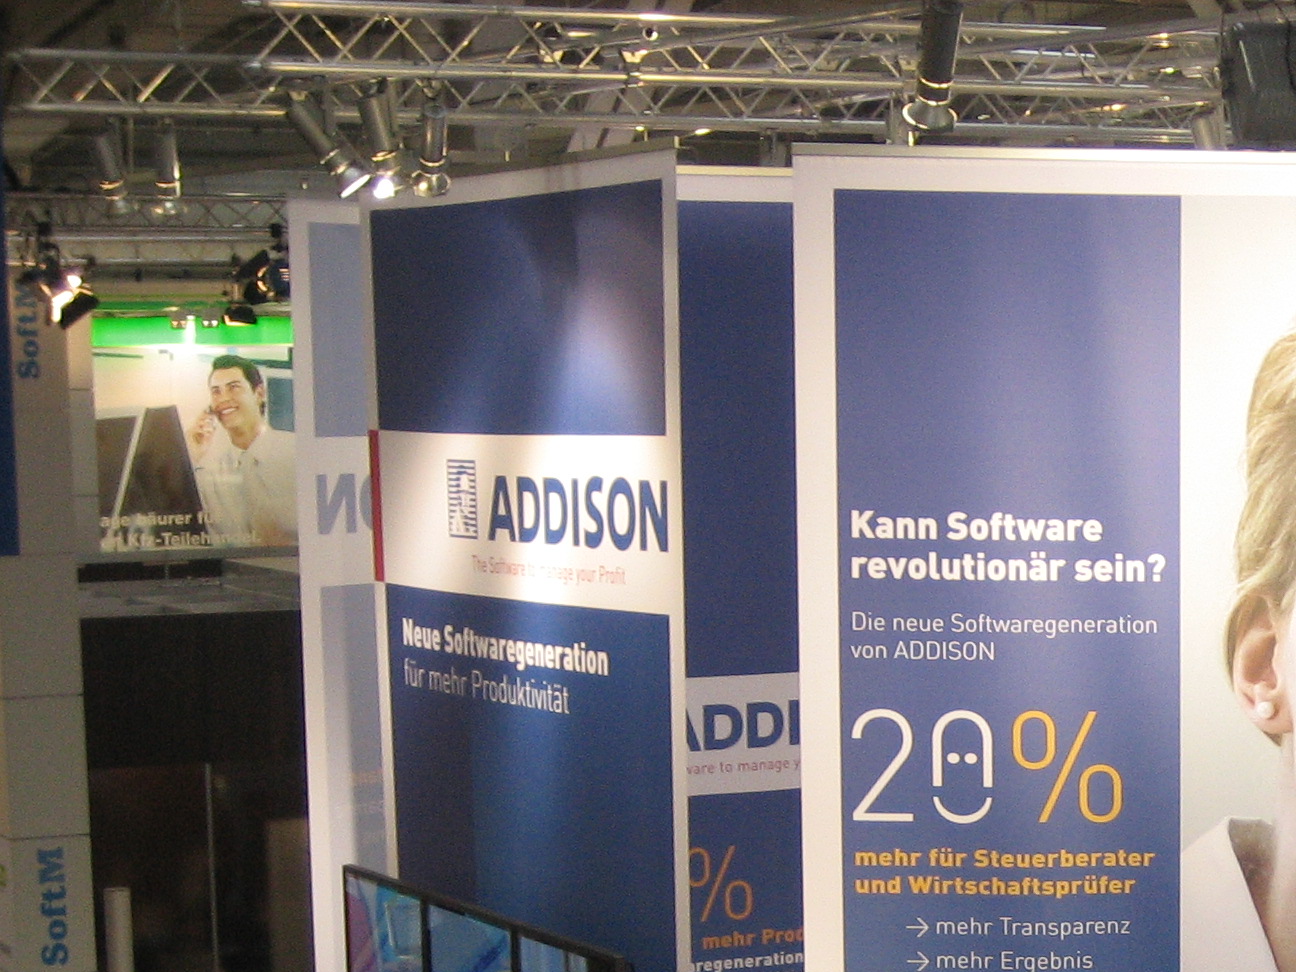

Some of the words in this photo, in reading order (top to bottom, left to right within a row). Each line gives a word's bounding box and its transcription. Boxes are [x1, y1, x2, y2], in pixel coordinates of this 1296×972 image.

[488, 475, 670, 553] ADDISON
[850, 509, 939, 541] Kann
[946, 510, 1104, 543] Software
[471, 554, 488, 574] The
[489, 556, 526, 578] Software
[599, 564, 627, 586] Profit
[850, 551, 1067, 582] revolutionär
[1074, 552, 1167, 583] sein?
[851, 611, 886, 632] Die
[892, 616, 945, 633] neue
[950, 612, 1159, 639] Softwaregeneration
[402, 617, 441, 652] Neue
[443, 623, 610, 677] Softwaregeneration
[850, 645, 888, 660] von
[893, 641, 996, 661] ADDISON
[403, 657, 425, 688] für
[428, 666, 468, 697] mehr
[471, 669, 571, 715] Produktivität
[719, 761, 733, 774] to
[738, 759, 790, 774] manage
[854, 848, 922, 868] mehr
[929, 847, 969, 868] für
[973, 848, 1156, 869] Steuerberater
[854, 875, 902, 895] und
[907, 874, 1137, 900] Wirtschaftsprüfer
[37, 846, 69, 967] SoftM
[702, 930, 757, 950] mehr
[935, 917, 994, 937] mehr
[999, 916, 1131, 941] Transparenz
[936, 951, 994, 970] mehr
